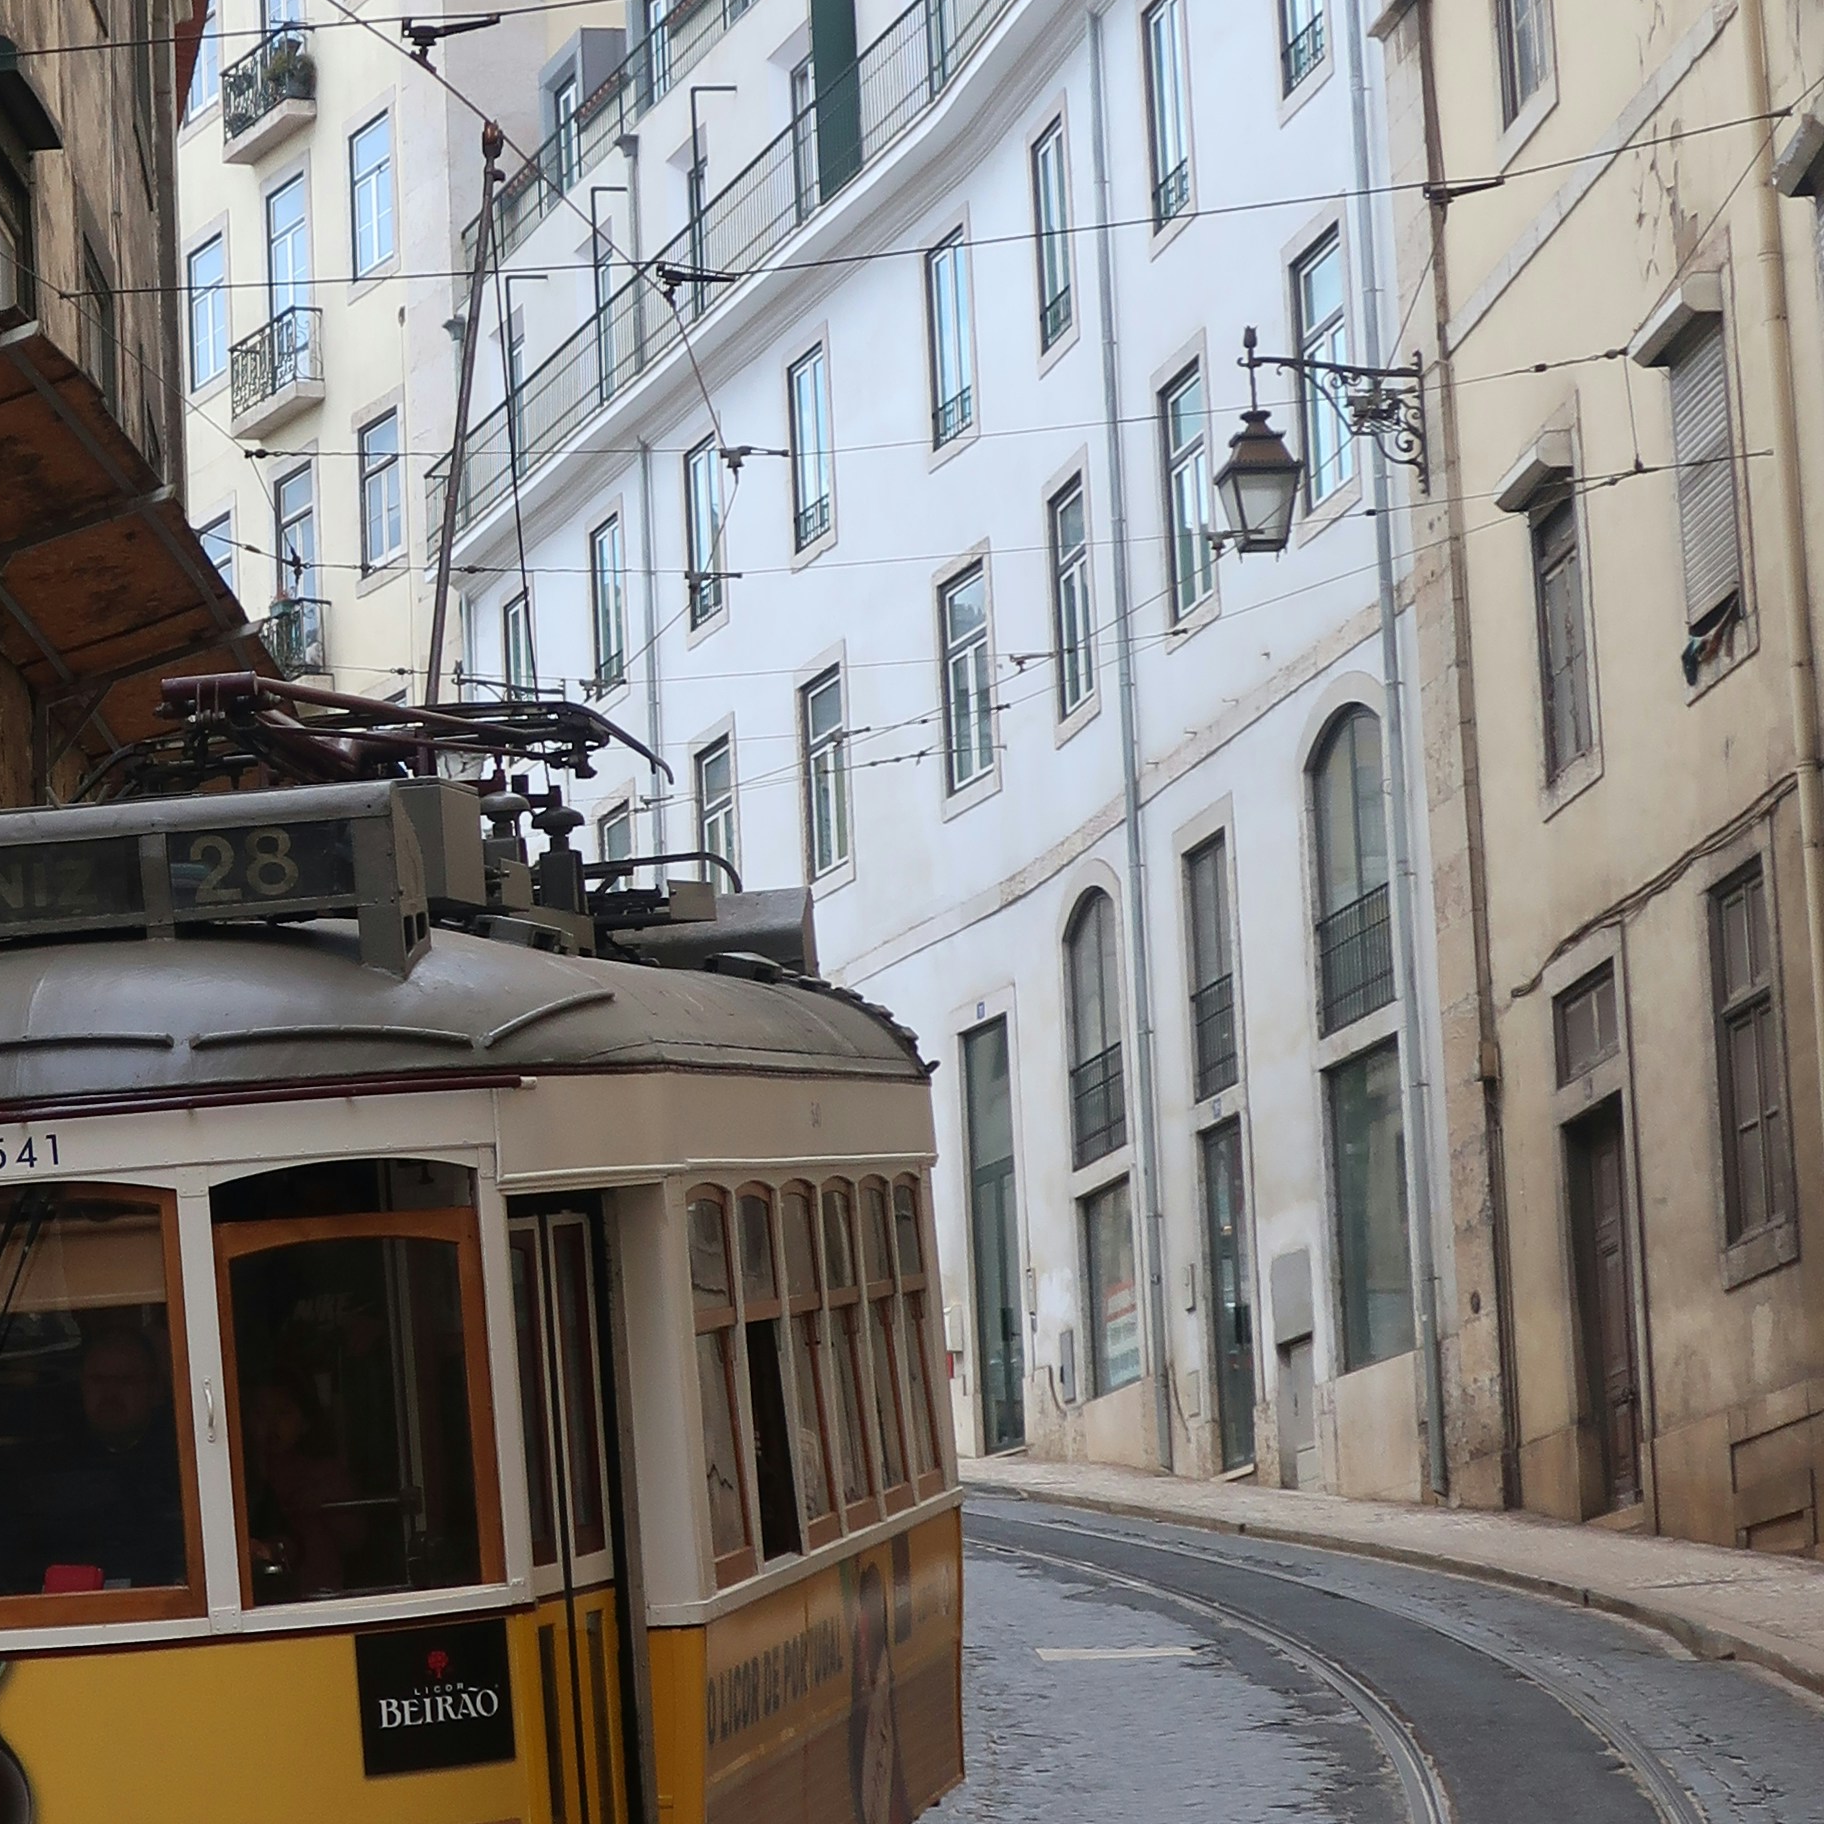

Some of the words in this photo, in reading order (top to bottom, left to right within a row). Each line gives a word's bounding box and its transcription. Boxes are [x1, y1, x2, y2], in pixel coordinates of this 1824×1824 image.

[189, 827, 299, 904] 28
[378, 1686, 499, 1729] BEIRÃO
[413, 1682, 465, 1696] LICOR
